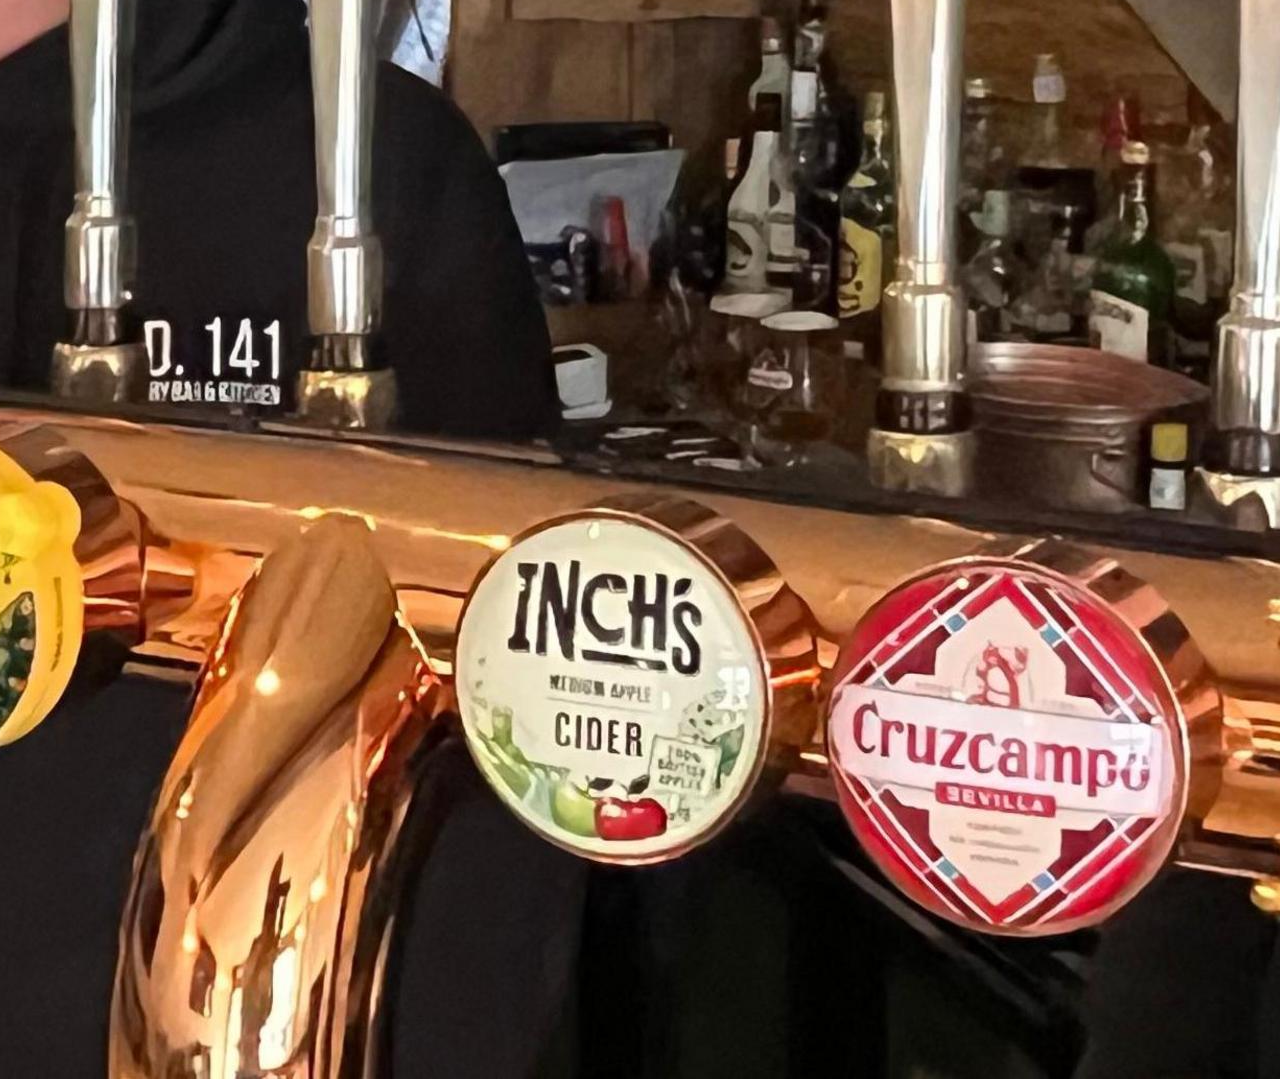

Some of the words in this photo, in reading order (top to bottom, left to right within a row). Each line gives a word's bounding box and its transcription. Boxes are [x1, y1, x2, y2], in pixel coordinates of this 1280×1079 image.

[204, 316, 280, 380] 141
[554, 711, 644, 758] CIDER
[852, 699, 1151, 798] Cruzcampo
[945, 785, 1045, 813] SEVILLA
